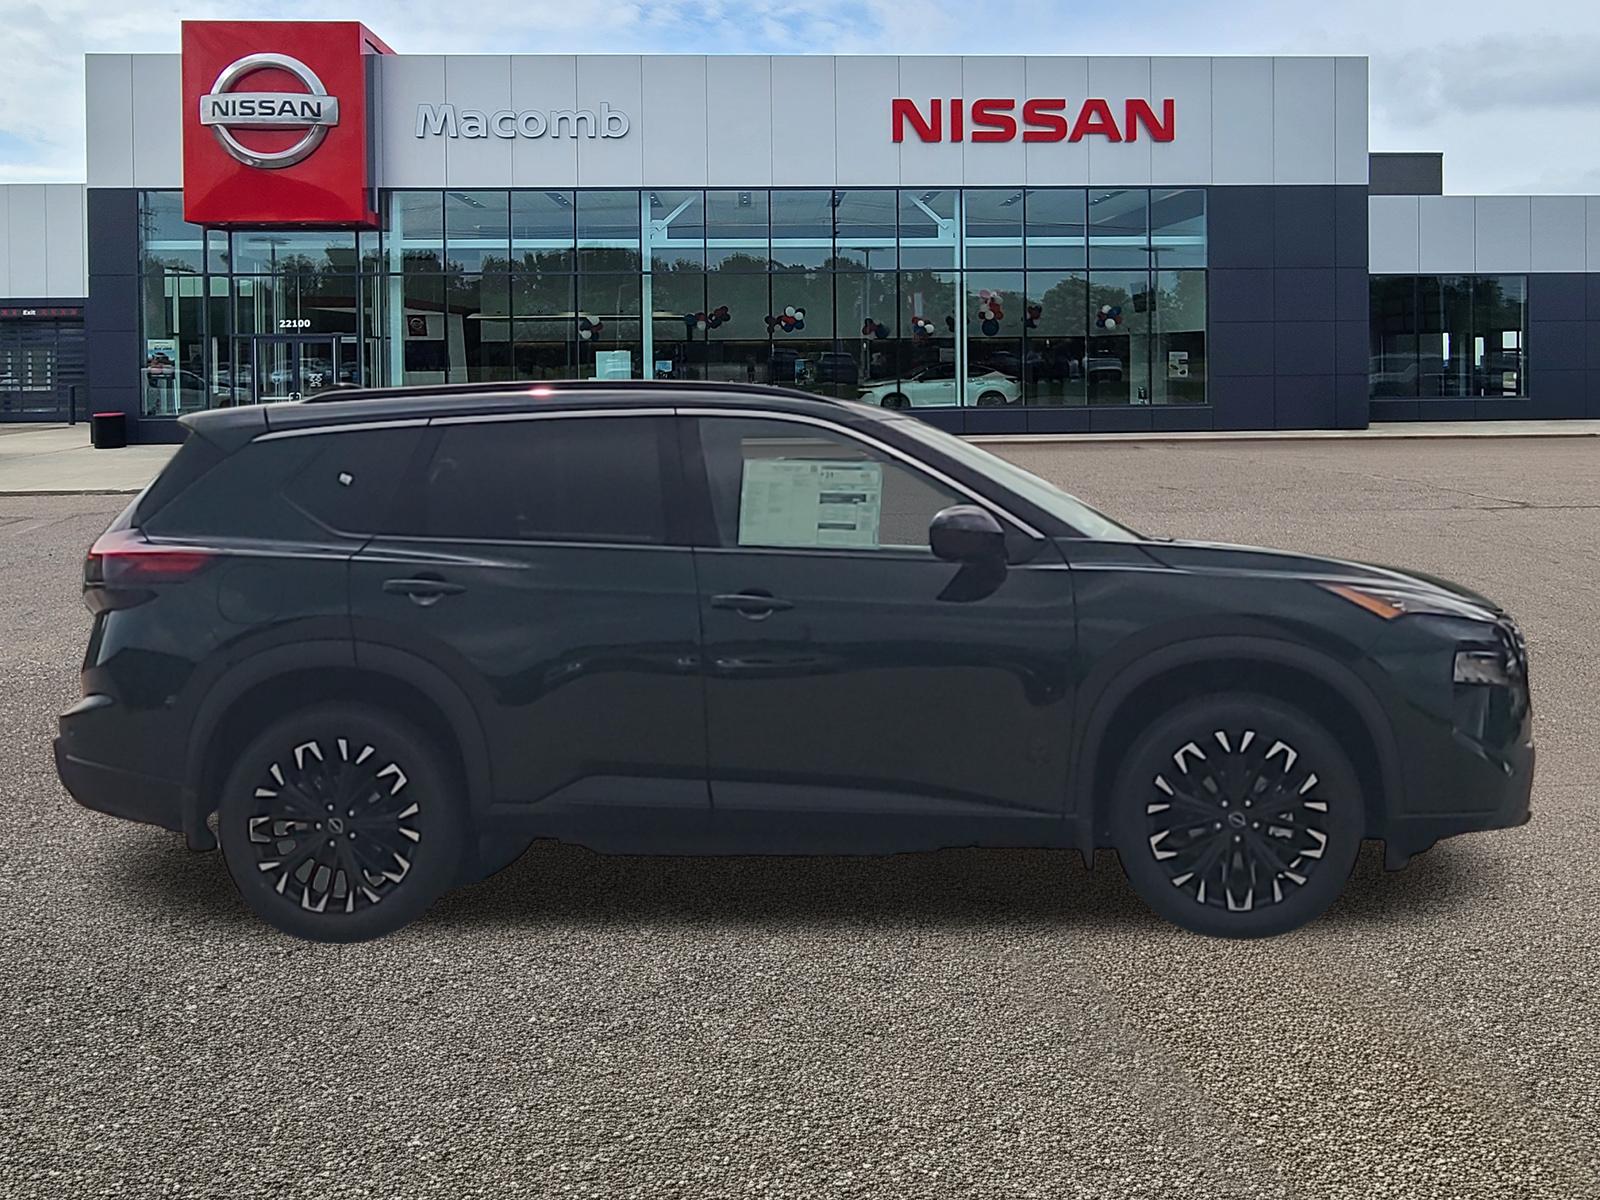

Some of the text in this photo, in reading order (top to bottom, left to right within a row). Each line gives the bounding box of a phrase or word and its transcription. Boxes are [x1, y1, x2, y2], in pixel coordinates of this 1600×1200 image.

[212, 100, 321, 117] NISSAN
[415, 101, 630, 139] Macomb
[892, 98, 1175, 143] NISSAN
[279, 319, 311, 328] 22100
